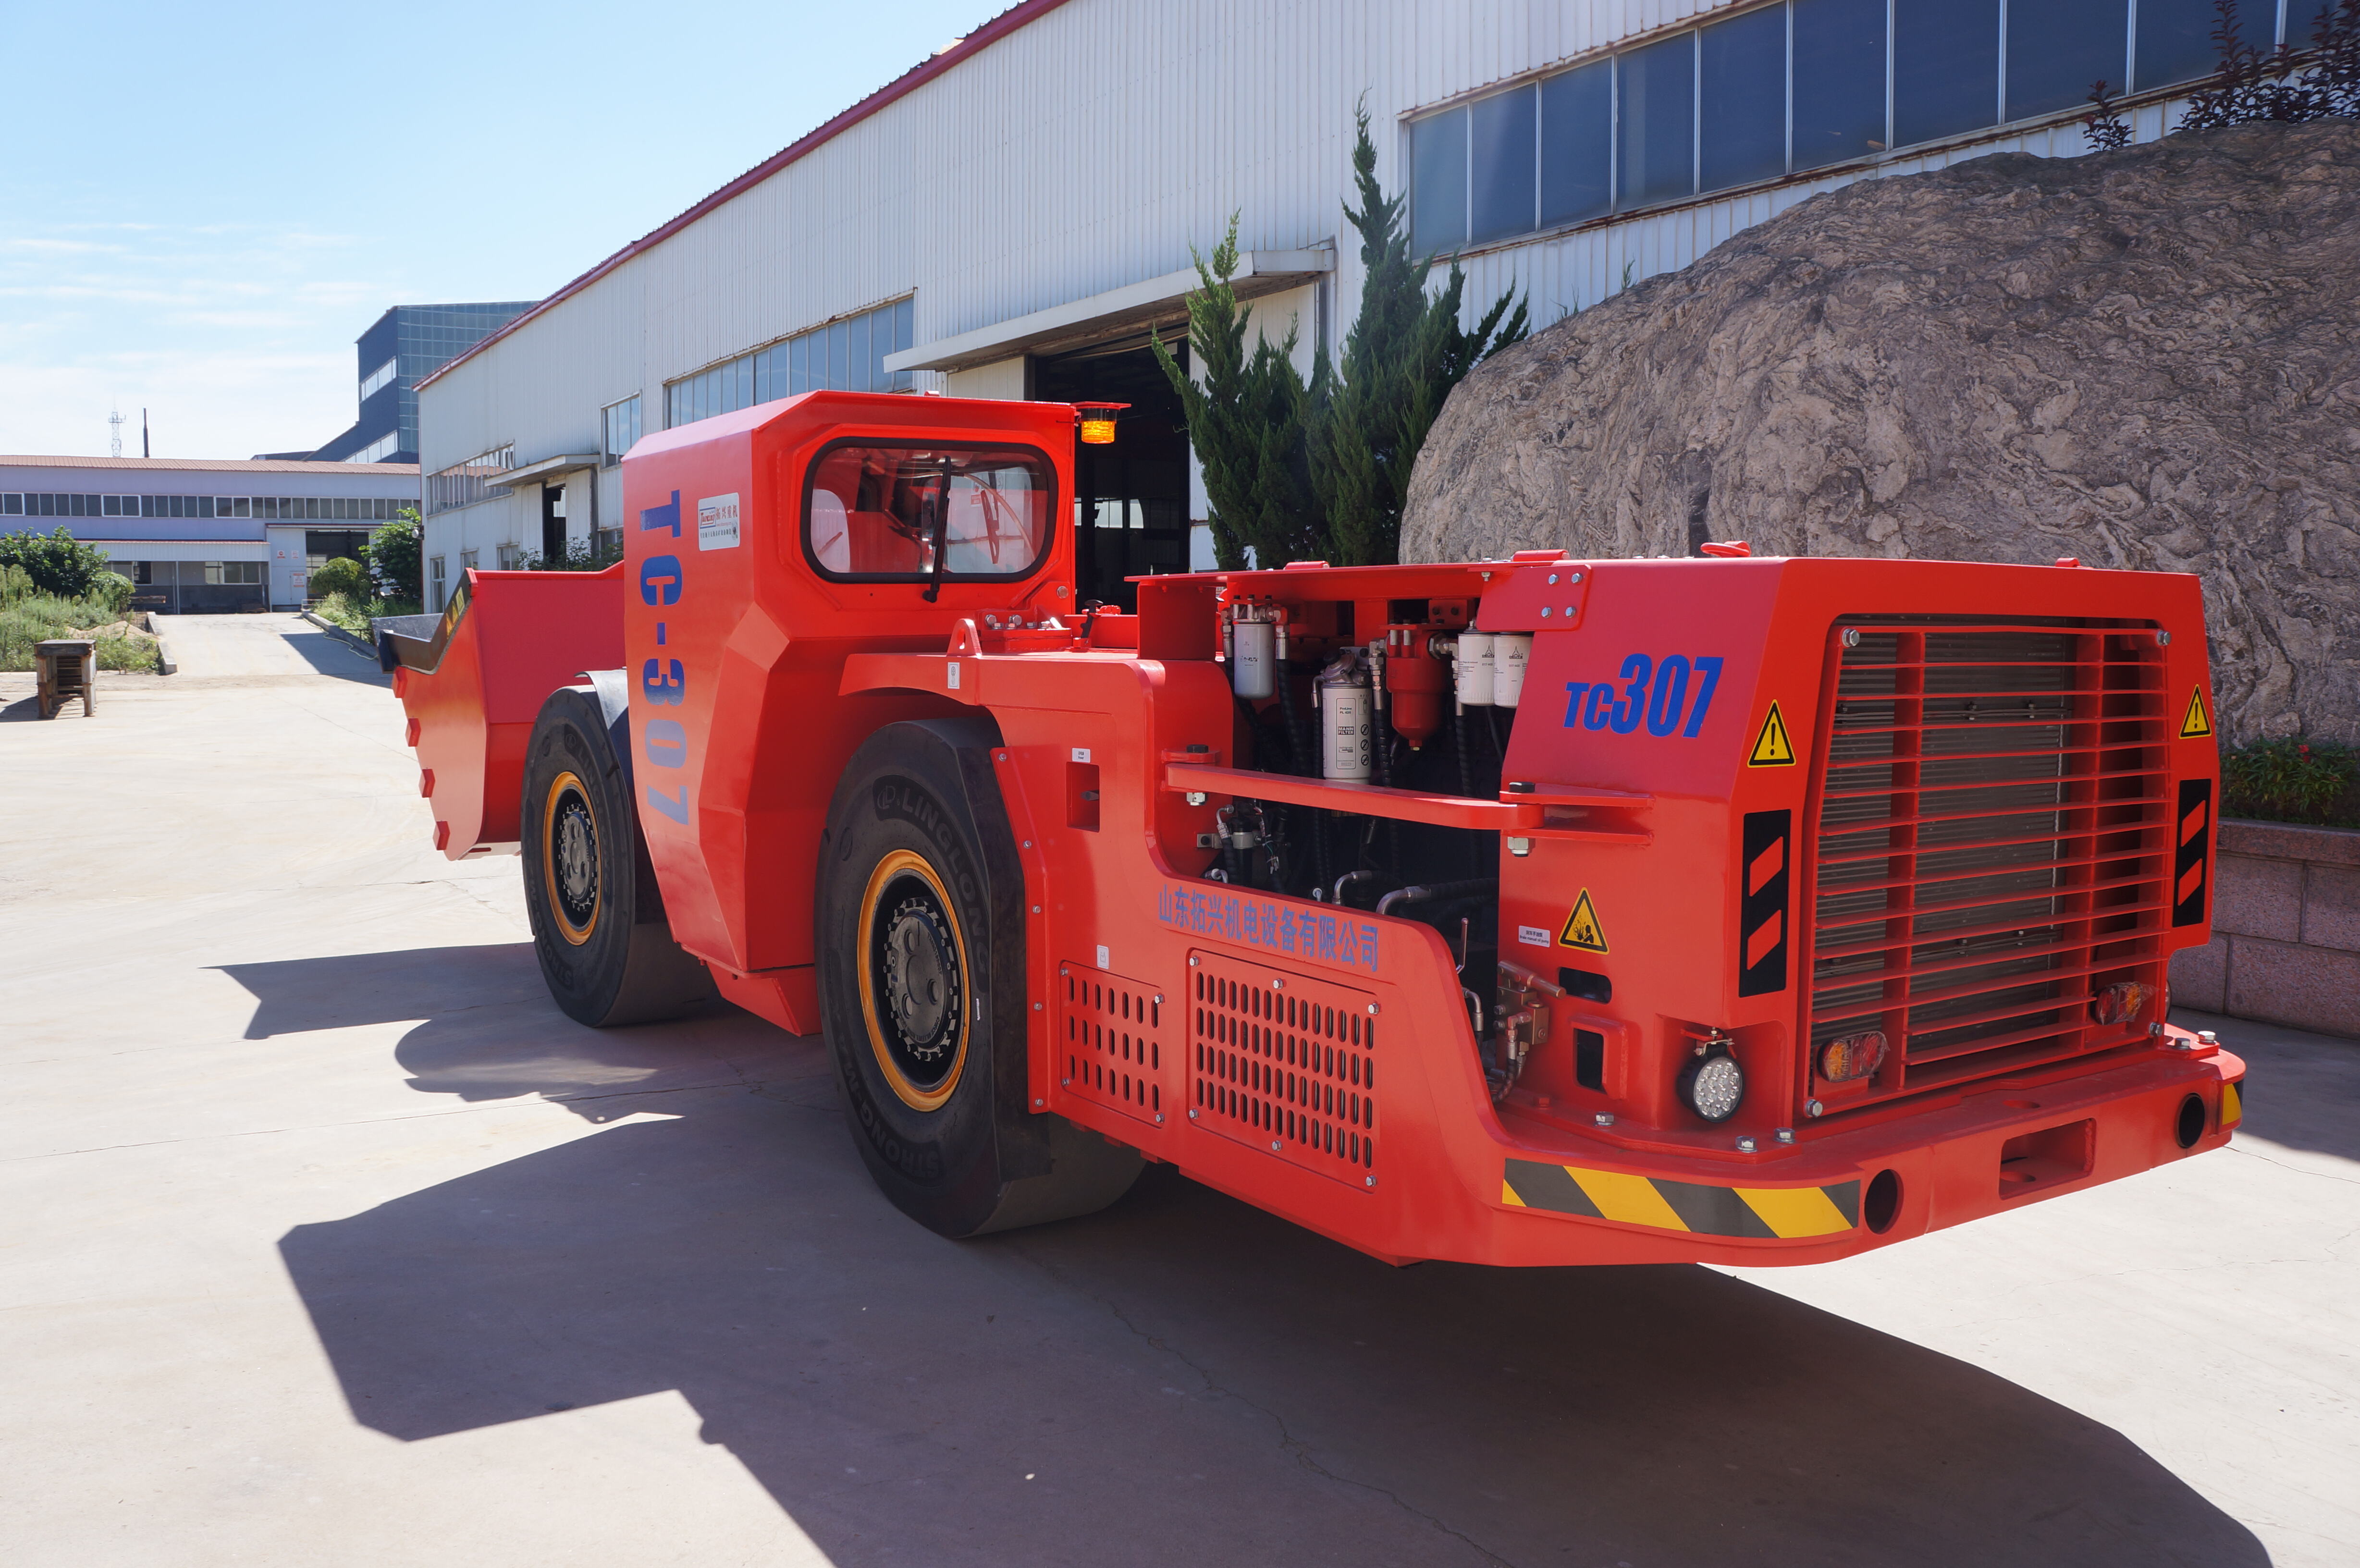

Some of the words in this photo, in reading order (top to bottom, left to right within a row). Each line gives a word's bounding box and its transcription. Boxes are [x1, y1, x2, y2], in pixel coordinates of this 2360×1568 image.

[639, 489, 688, 825] TC-307
[1563, 653, 1724, 738] TC307
[902, 787, 989, 974] LINGLONG
[1158, 883, 1378, 972] 山东拓兴机电设备有限公司
